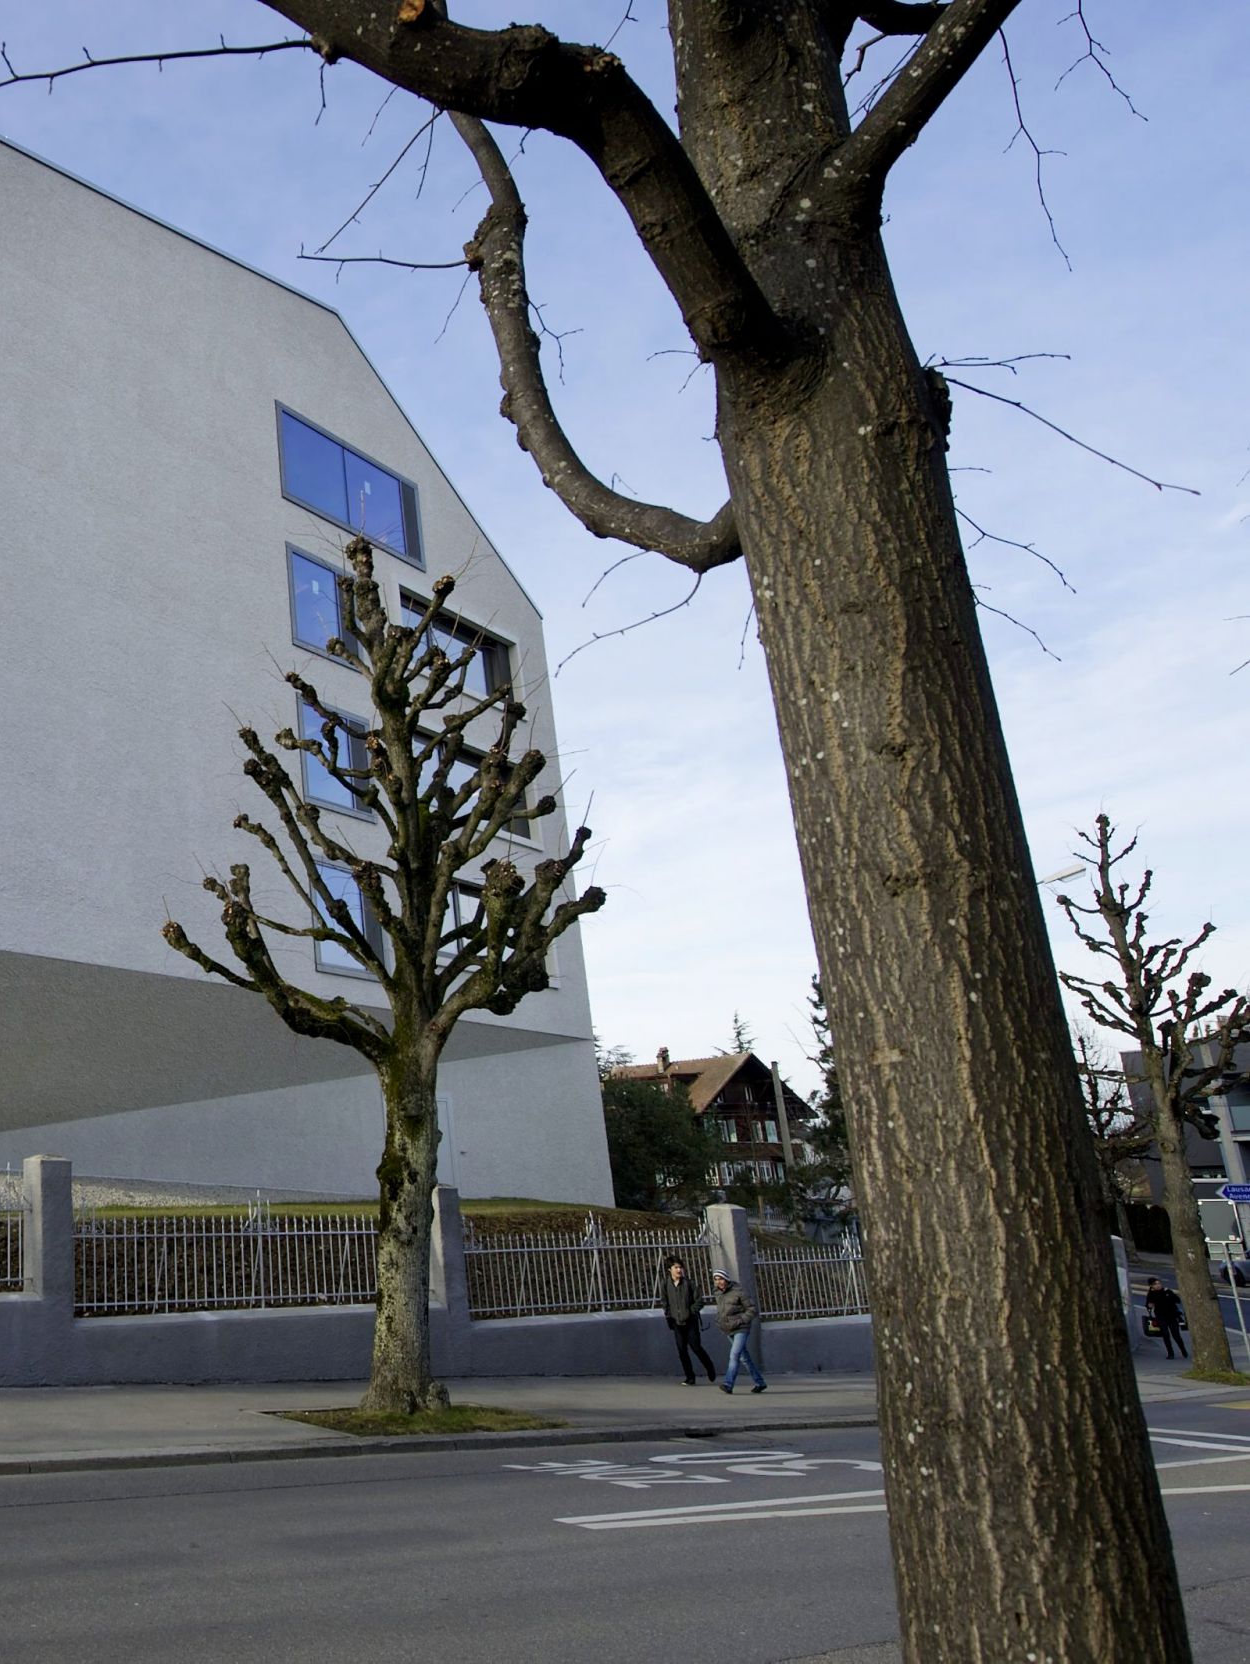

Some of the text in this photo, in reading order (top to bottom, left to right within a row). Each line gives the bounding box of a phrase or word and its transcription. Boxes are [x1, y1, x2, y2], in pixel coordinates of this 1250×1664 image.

[1226, 1185, 1250, 1193] Lausa
[501, 1459, 732, 1489] ZONE
[648, 1450, 883, 1477] 30
